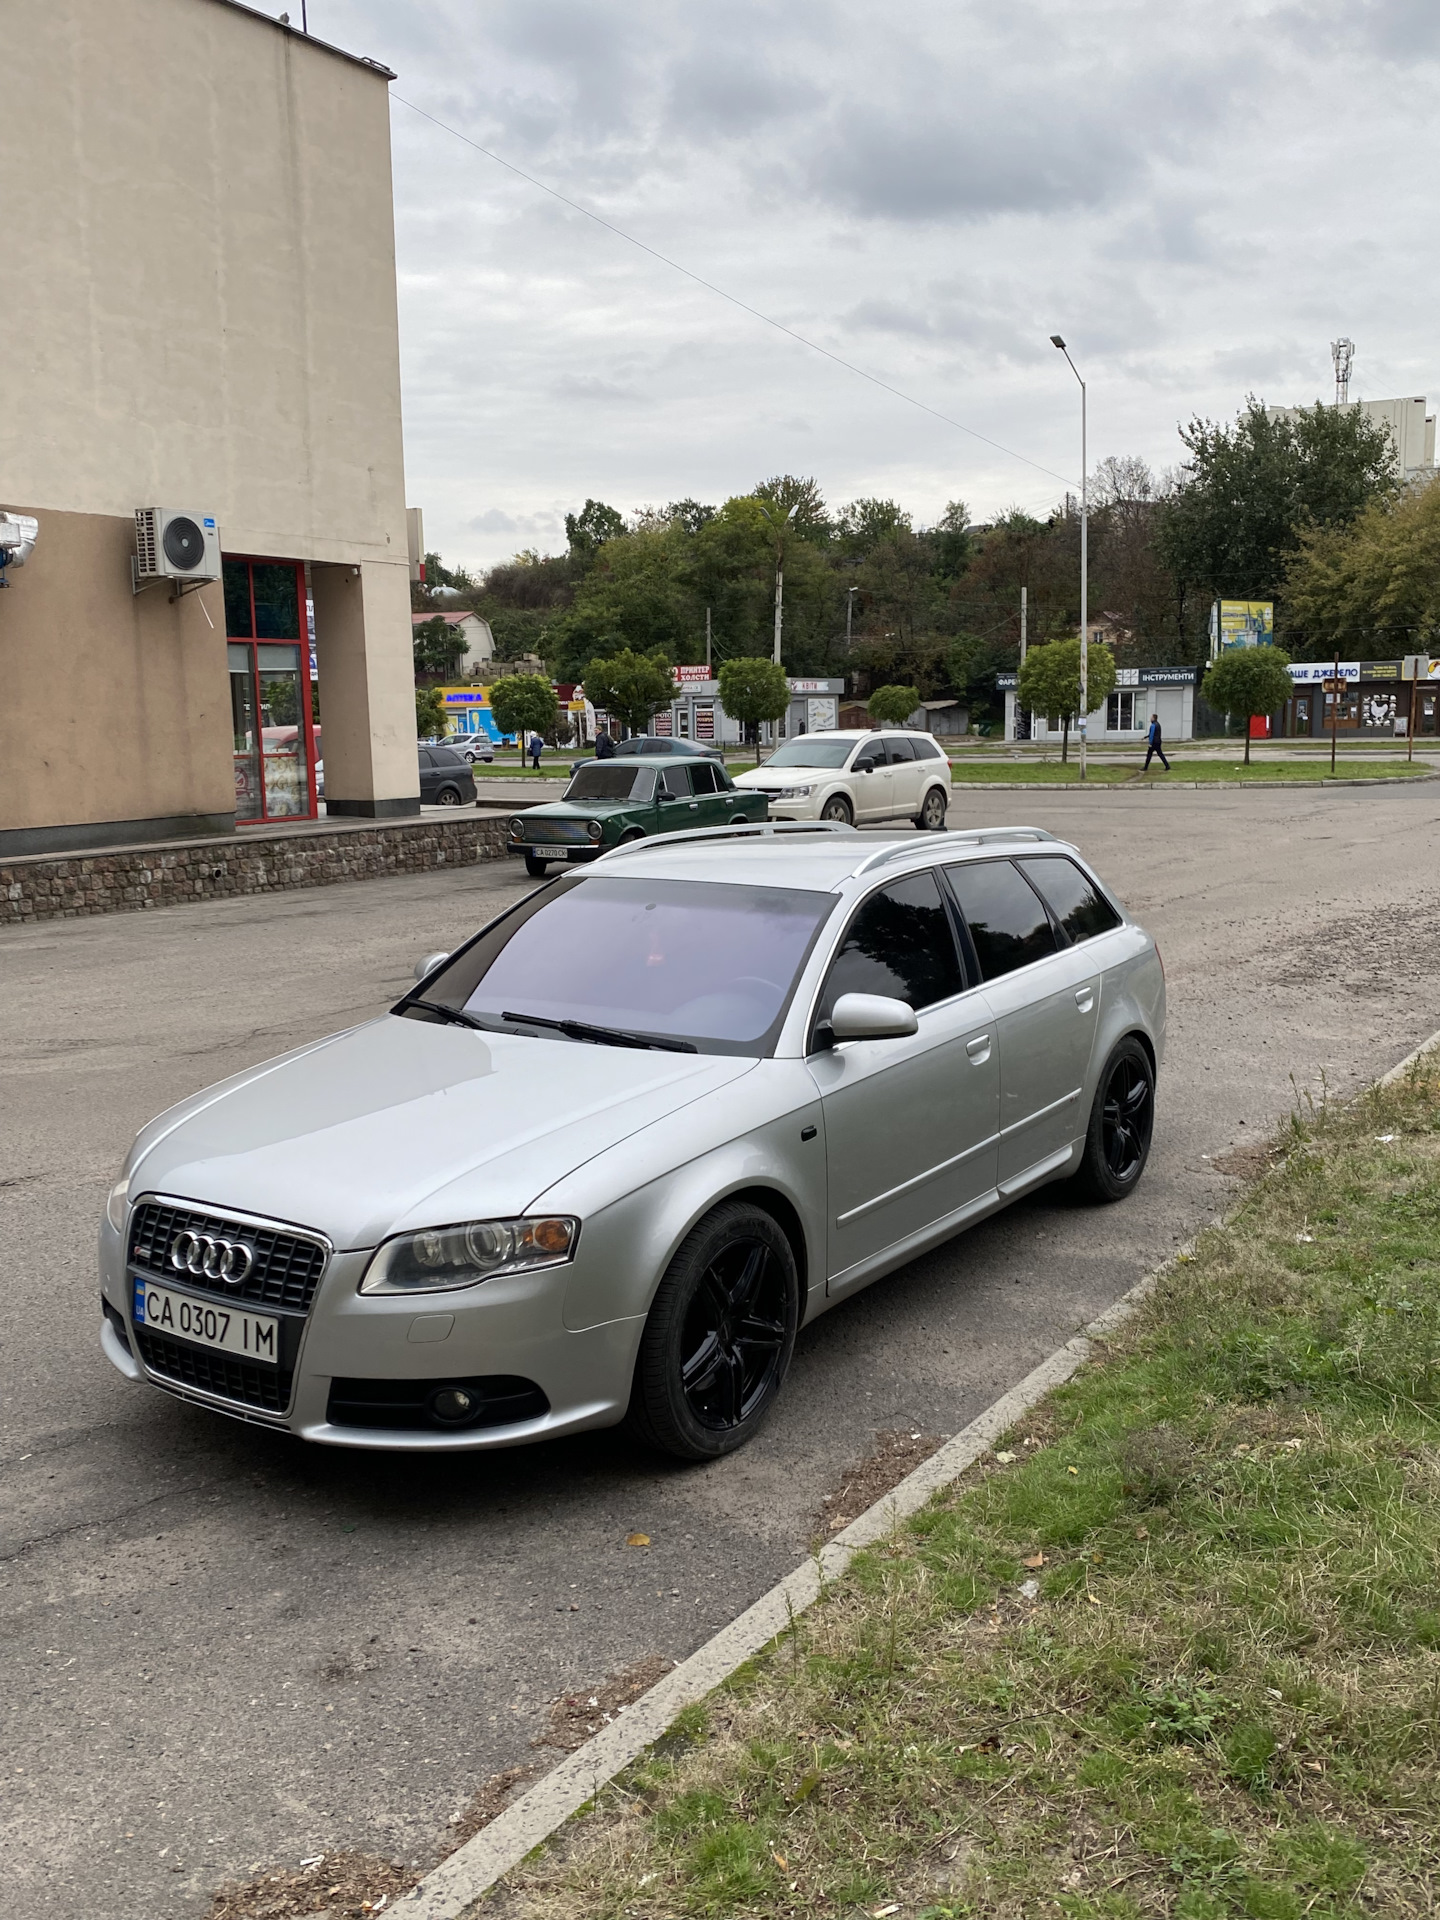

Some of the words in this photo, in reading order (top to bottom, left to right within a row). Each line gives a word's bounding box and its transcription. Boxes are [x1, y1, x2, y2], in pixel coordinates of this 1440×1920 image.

[680, 666, 710, 674] ПРИНТЕР
[1289, 669, 1309, 679] АШЕ
[1312, 668, 1358, 679] ДЖЕЕЛО
[1142, 673, 1194, 682] ІНСТРУМЕНТИ
[802, 682, 818, 690] КВІТИ
[446, 693, 483, 702] АПТЕКА
[136, 1304, 144, 1316] UA
[147, 1291, 175, 1328] CA
[180, 1302, 230, 1343] 0307
[243, 1318, 274, 1356] IM
